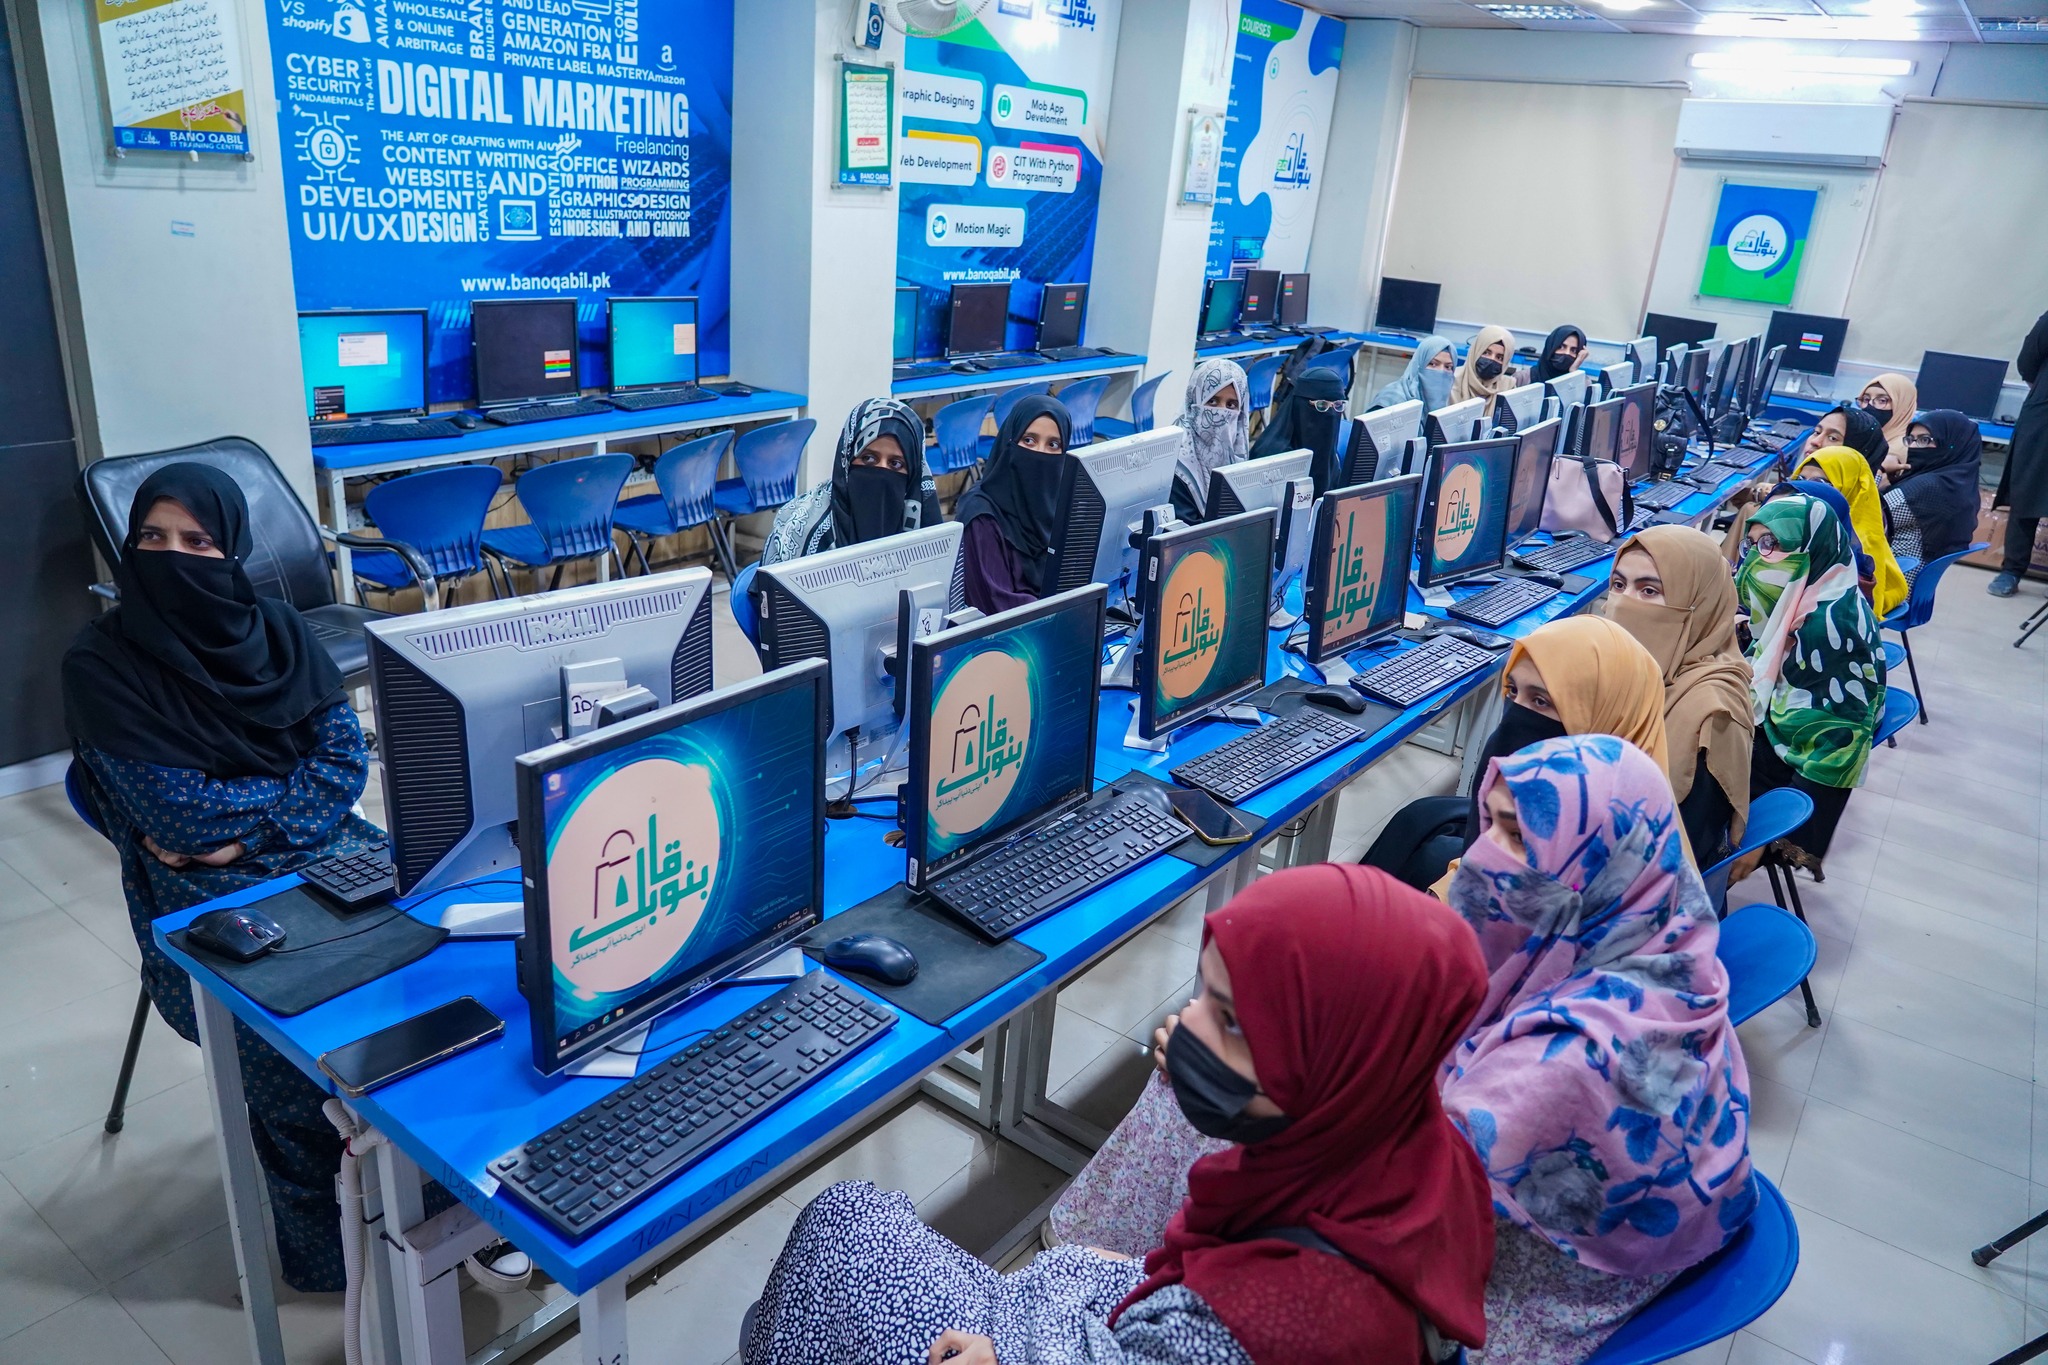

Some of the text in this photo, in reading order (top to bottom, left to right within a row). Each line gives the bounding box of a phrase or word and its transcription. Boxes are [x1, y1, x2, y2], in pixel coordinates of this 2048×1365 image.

[280, 0, 305, 15] VS
[393, 1, 468, 22] WHOLESALE
[537, 0, 571, 16] LEAD
[282, 15, 332, 34] shopify
[395, 18, 455, 38] & ONLINE
[485, 8, 496, 61] BUILDER
[501, 11, 612, 44] GENERATION
[1241, 17, 1272, 38] COURSES
[396, 36, 464, 55] ARBITRAGE
[502, 31, 613, 61] AMAZON FBA
[286, 53, 360, 80] CYBER
[503, 51, 649, 81] PRIVATE LABEL MASTERY
[288, 75, 362, 95] SECURITY
[362, 57, 375, 112] The Art of
[648, 72, 686, 86] Amazon
[289, 92, 364, 107] FUNDAMENTALS
[377, 59, 690, 139] DIGITAL MARKETING
[903, 87, 975, 110] raphic Designing
[1031, 99, 1065, 114] Mob App
[1025, 111, 1068, 126] Develoment
[169, 131, 205, 142] BANO
[208, 133, 244, 145] QABIL
[216, 143, 244, 151] CENTRE
[380, 129, 404, 142] THE
[407, 131, 430, 144] ART
[432, 133, 449, 145] OF
[451, 134, 505, 149] CRAFTING
[507, 138, 534, 150] WITH
[615, 134, 690, 161] Freelancing
[382, 145, 548, 171] CONTENT WRITING
[559, 155, 690, 178] OFFICE WIZARDS
[900, 155, 915, 167] eb
[917, 156, 972, 172] Development
[1014, 155, 1075, 174] CIT With Python
[385, 166, 474, 188] WEBSITE
[487, 170, 547, 197] AND
[560, 173, 690, 190] TO PYTHON PROGRAMMING
[1012, 170, 1063, 187] Programming
[299, 184, 475, 211] DEVELOPMENT
[476, 170, 490, 242] CHATGPT
[561, 191, 691, 210] GRAPHICS DESIGN
[562, 208, 691, 221] ADOBE ILLUSTRATOR PHOTOSHOP
[302, 210, 400, 242] UI/UX
[401, 211, 477, 243] DESIGN
[626, 220, 651, 237] AND
[653, 220, 691, 238] CANVA
[955, 222, 1011, 237] Motion Magic
[461, 272, 611, 293] www.banoqabil.pk
[943, 267, 1022, 282] www.banoqabil.pk
[528, 612, 597, 642] DELL
